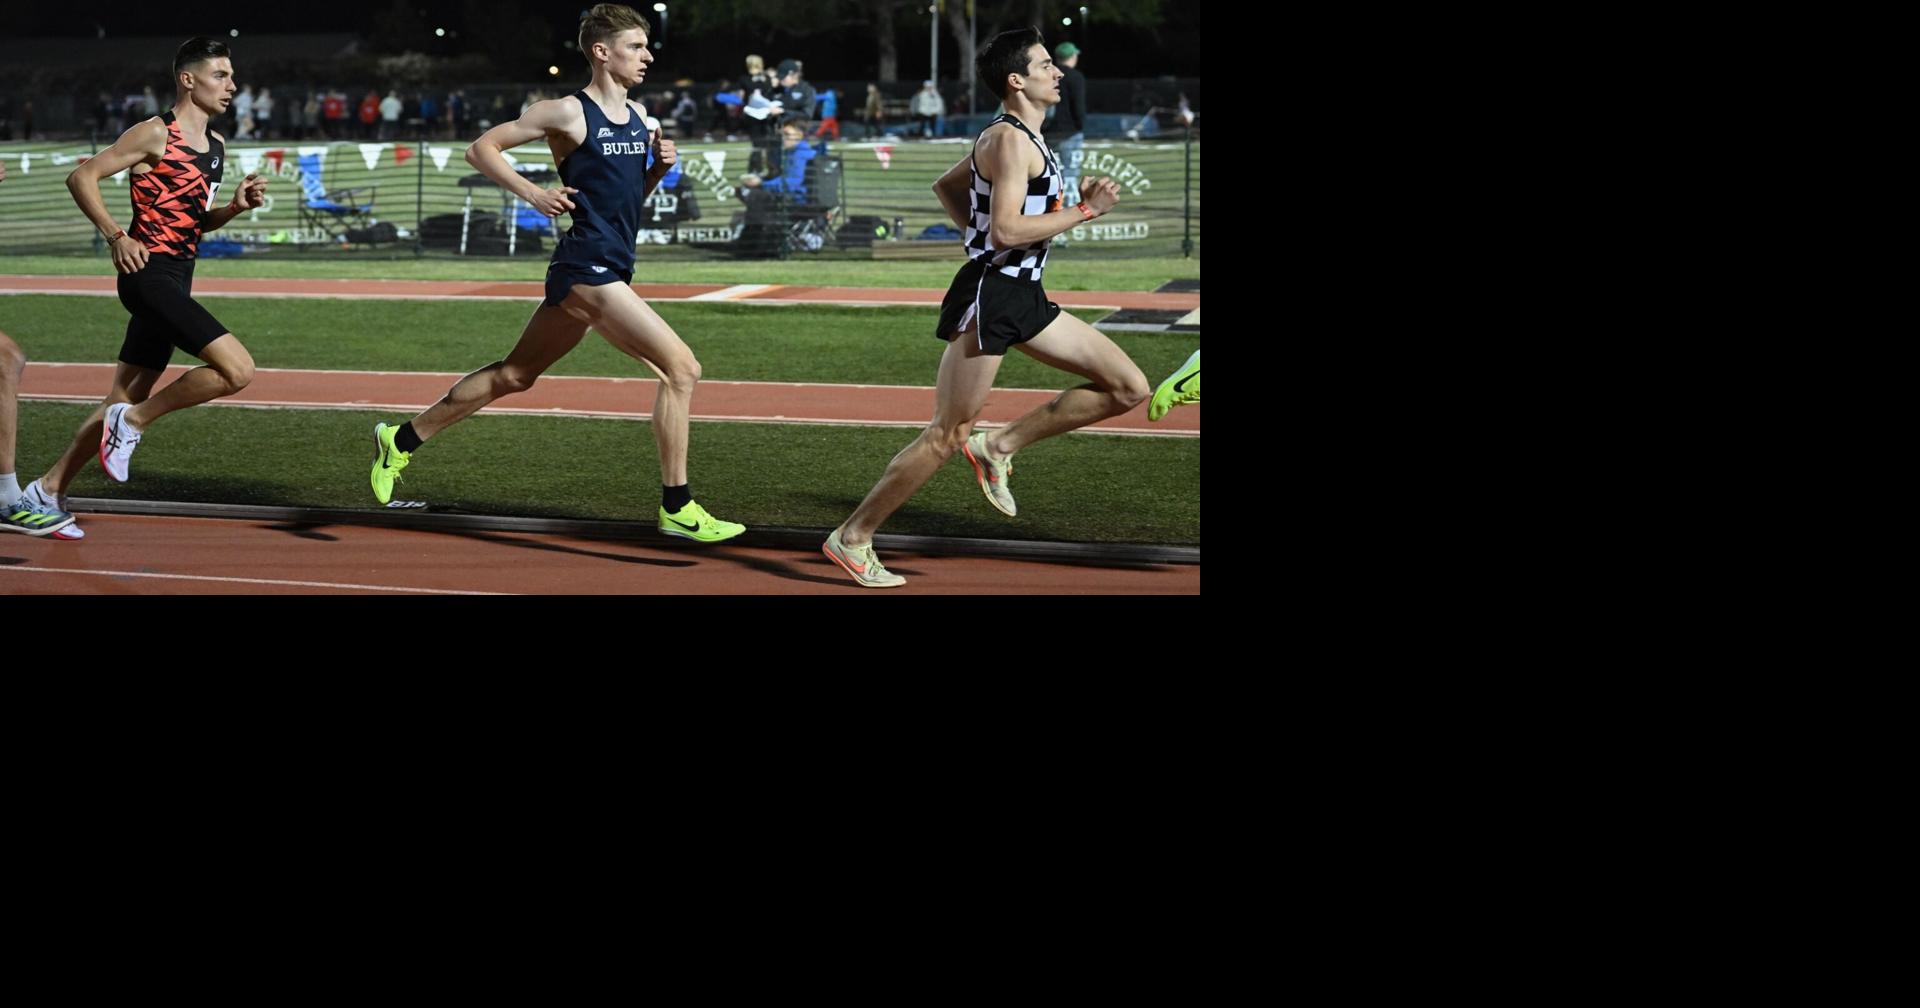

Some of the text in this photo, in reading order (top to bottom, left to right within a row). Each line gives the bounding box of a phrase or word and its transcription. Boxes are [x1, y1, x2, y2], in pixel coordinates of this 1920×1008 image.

[602, 141, 646, 155] BUTLER
[1069, 150, 1152, 196] PACIFIC
[677, 227, 733, 243] FIELD
[1091, 221, 1150, 241] FIELD
